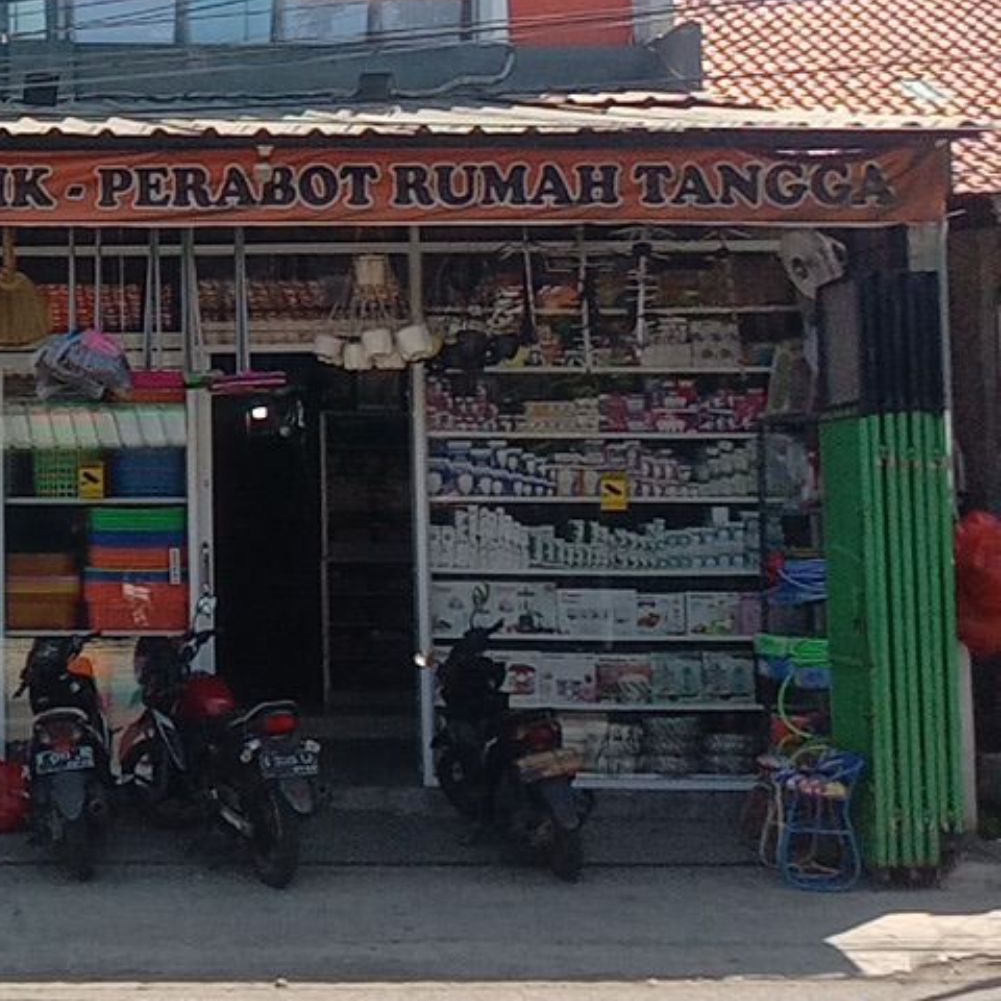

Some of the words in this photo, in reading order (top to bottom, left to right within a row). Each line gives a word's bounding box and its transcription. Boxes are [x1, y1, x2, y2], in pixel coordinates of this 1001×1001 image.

[94, 162, 378, 209] PERABOT
[392, 162, 621, 208] RUMAH
[633, 161, 898, 207] TANGGA
